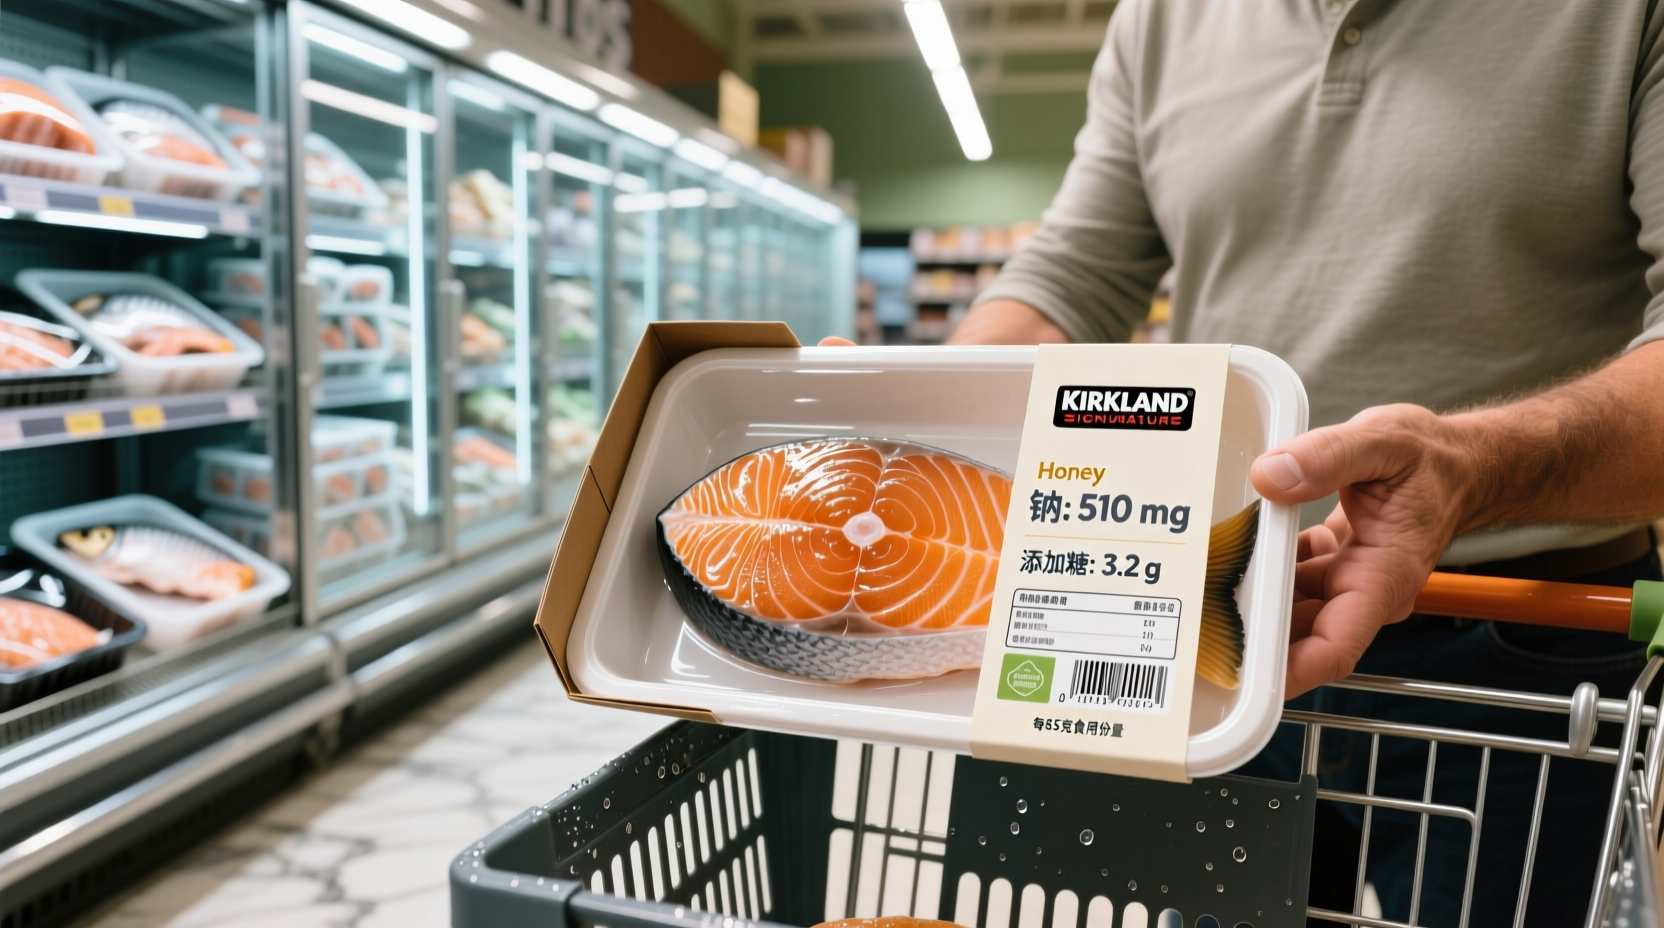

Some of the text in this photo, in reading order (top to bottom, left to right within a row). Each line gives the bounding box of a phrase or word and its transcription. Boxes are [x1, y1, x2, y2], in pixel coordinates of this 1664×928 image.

[1061, 389, 1189, 414] KIRKLAND
[1037, 461, 1106, 487] Honey
[1029, 488, 1191, 534] 钠: 510 mg
[1019, 549, 1162, 585] 添加糖: 3.2 g
